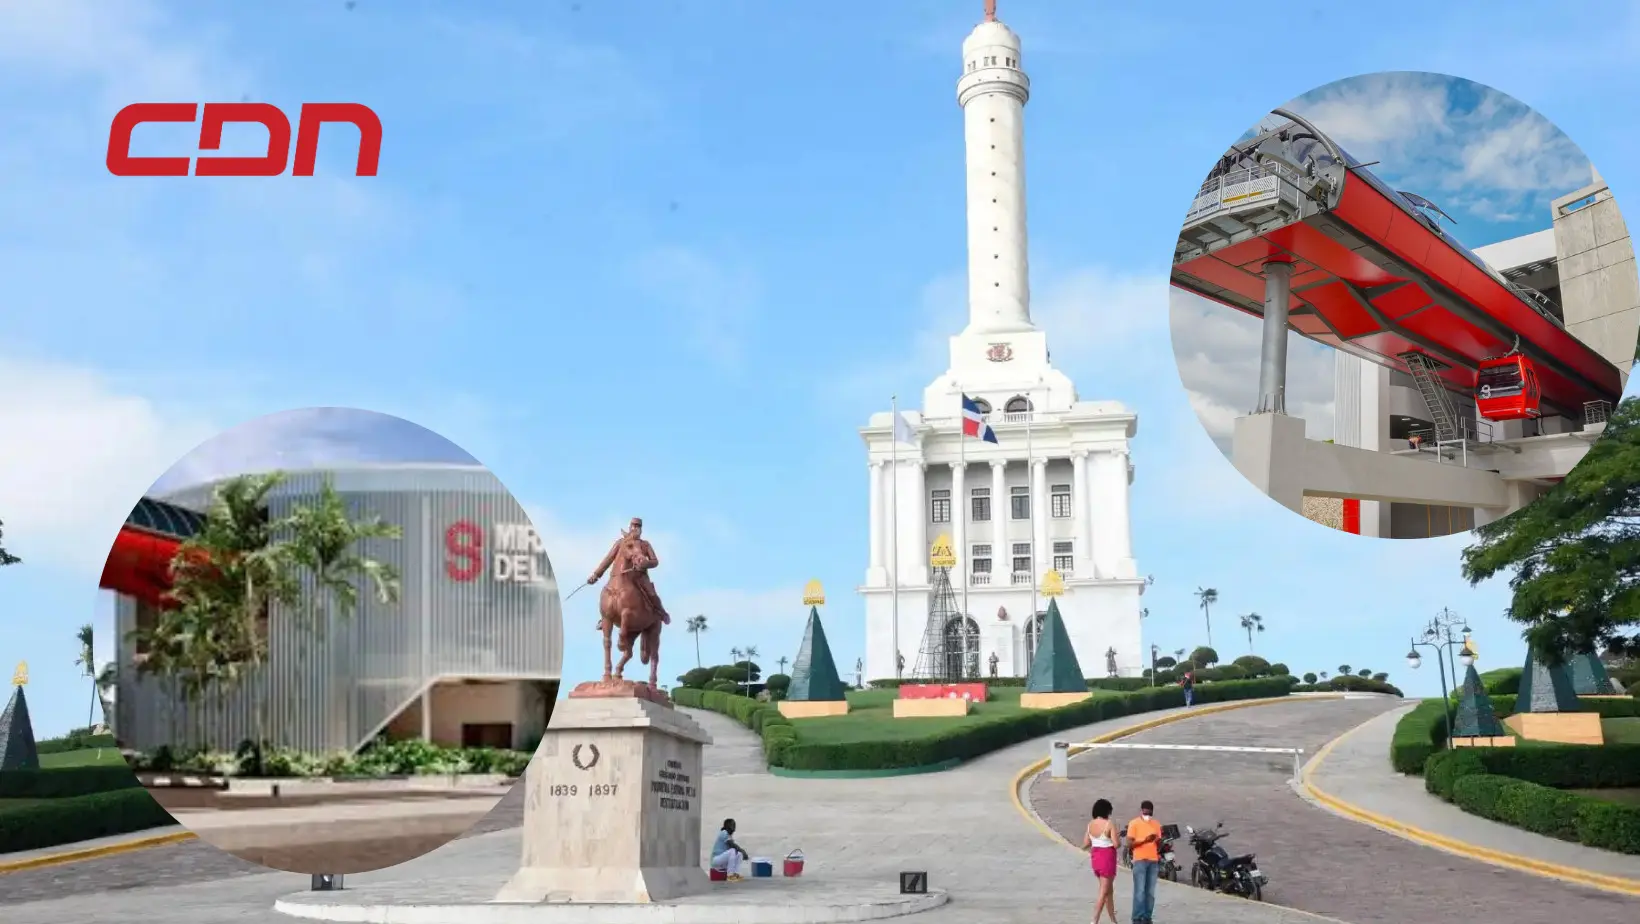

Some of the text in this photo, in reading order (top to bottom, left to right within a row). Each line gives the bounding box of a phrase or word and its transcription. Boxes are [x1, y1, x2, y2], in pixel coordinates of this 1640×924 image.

[494, 554, 544, 582] DEL
[550, 784, 618, 797] 1839 1897
